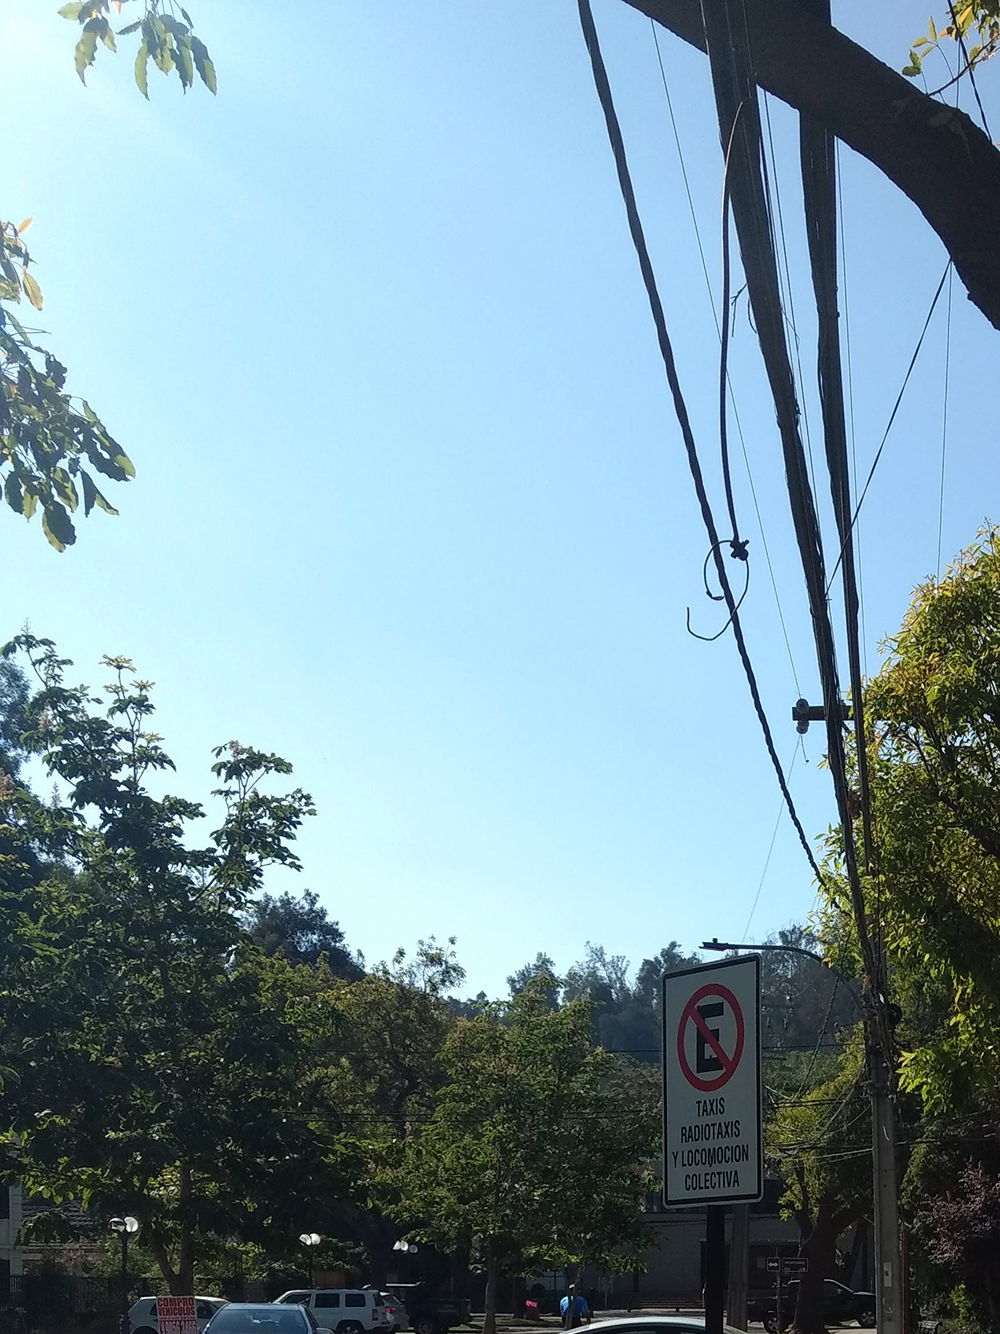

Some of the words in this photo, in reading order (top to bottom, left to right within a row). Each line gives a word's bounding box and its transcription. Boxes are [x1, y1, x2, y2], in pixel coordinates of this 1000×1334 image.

[696, 1097, 725, 1117] TAXIS
[681, 1120, 741, 1143] RADIOTAXIS
[672, 1151, 679, 1168] Y
[681, 1144, 749, 1167] LOCOMOCION
[685, 1170, 740, 1191] COLECTIVA
[157, 1297, 194, 1307] COMPRO
